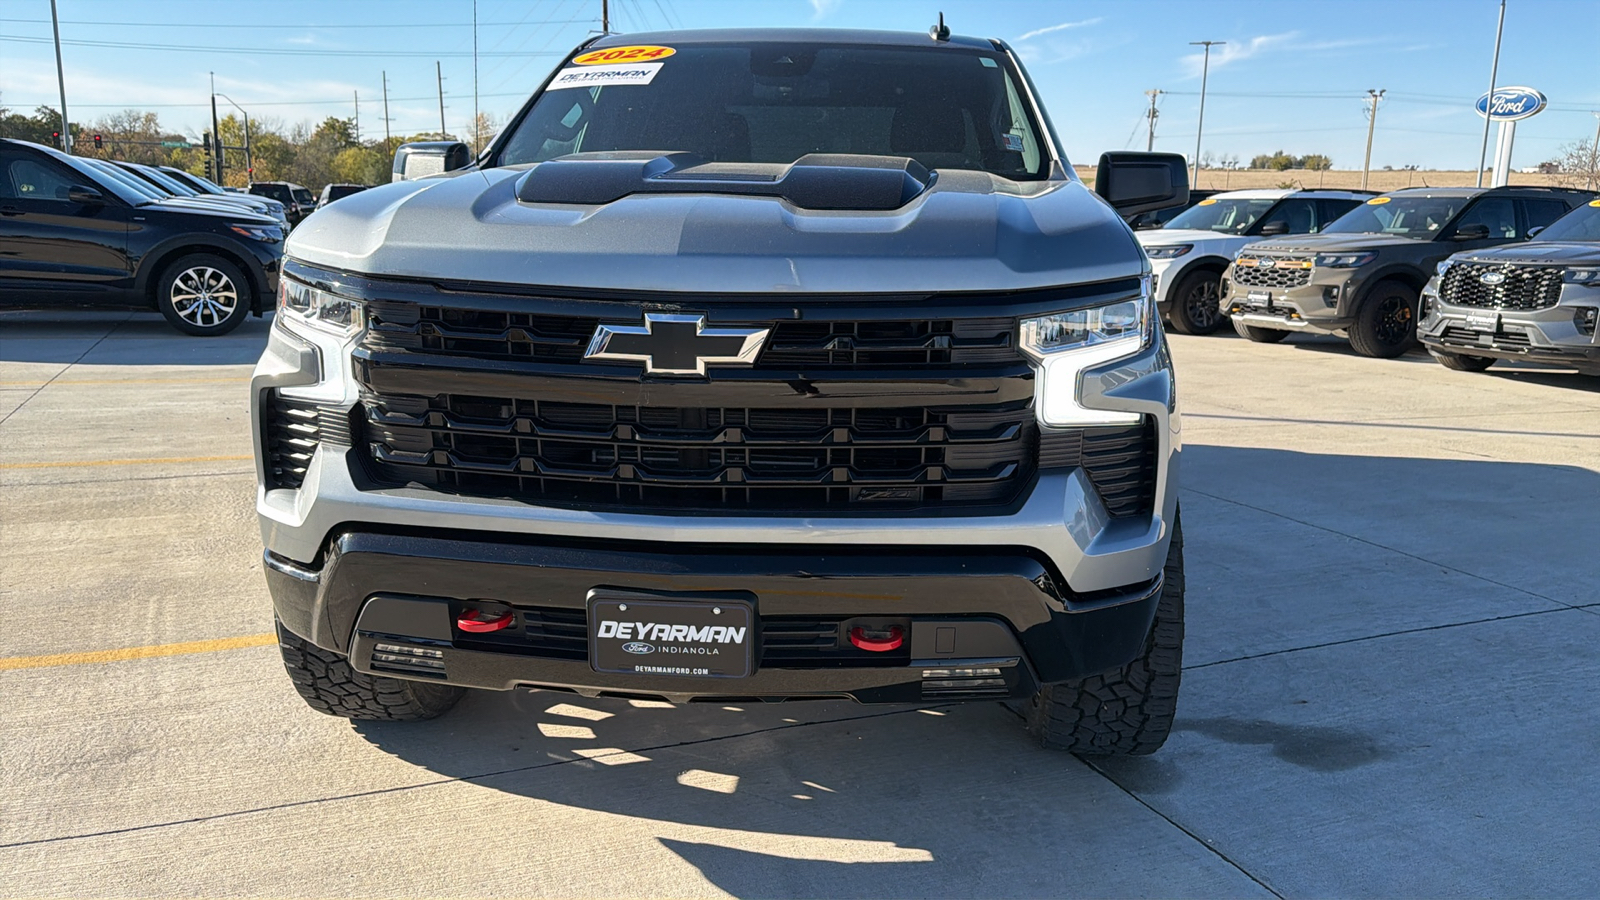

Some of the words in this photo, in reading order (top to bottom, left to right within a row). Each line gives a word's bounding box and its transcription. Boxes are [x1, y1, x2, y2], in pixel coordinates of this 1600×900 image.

[580, 48, 668, 63] 2024
[559, 69, 652, 82] DEYARMAN
[1490, 93, 1527, 114] Ford
[597, 620, 747, 644] DEYARMAN
[628, 642, 649, 652] Ford
[658, 646, 720, 655] INDIANOLA
[635, 665, 709, 675] DEYARMANFORD.COM
